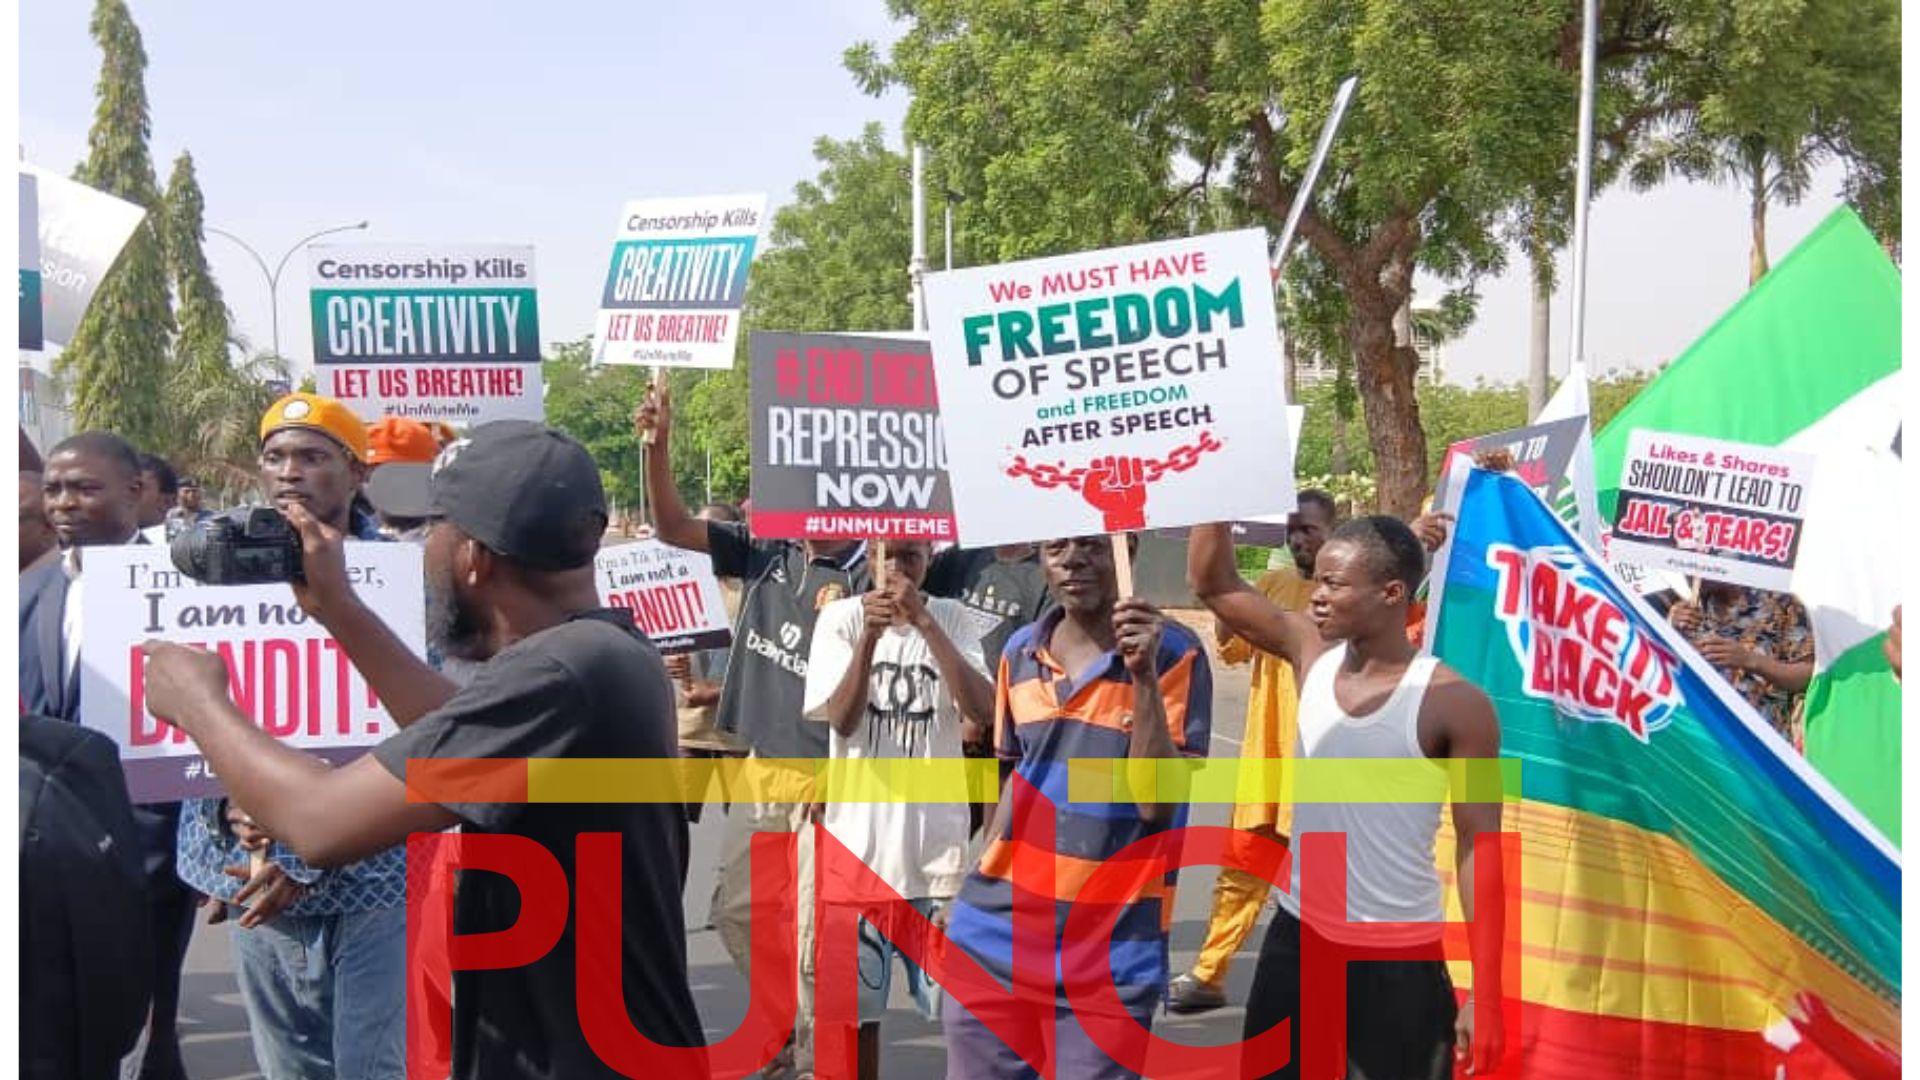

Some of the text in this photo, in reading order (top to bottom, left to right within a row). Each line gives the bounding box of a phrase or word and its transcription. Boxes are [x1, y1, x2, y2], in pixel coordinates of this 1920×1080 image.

[627, 208, 758, 233] Censorship Kills
[317, 258, 527, 283] Censorship Kills
[614, 243, 746, 301] CREATIVITY
[989, 252, 1208, 303] We MUST HAVE
[326, 296, 521, 356] CREATIVITY
[608, 314, 729, 343] LET US BREATHE!
[962, 276, 1244, 367] FREEDOM
[333, 368, 524, 398] LET US BREATHE!
[992, 338, 1227, 399] OF SPEECH
[1037, 384, 1188, 420] and FREEDOM
[1022, 405, 1213, 448] AFTER SPEECH
[1649, 443, 1790, 478] Likes & Shares
[816, 472, 936, 509] NOW
[1629, 459, 1802, 513] SHOULDN'T LEAD TO
[805, 517, 949, 536] #UNMUTEME
[1620, 501, 1794, 561] JAIL & TEARS!
[127, 564, 181, 589] I'm
[606, 562, 689, 588] I am not a
[144, 592, 309, 632] I am no
[1496, 550, 1678, 696] TAKE IT
[130, 639, 380, 747] BNDIT!
[1533, 630, 1651, 737] BACK
